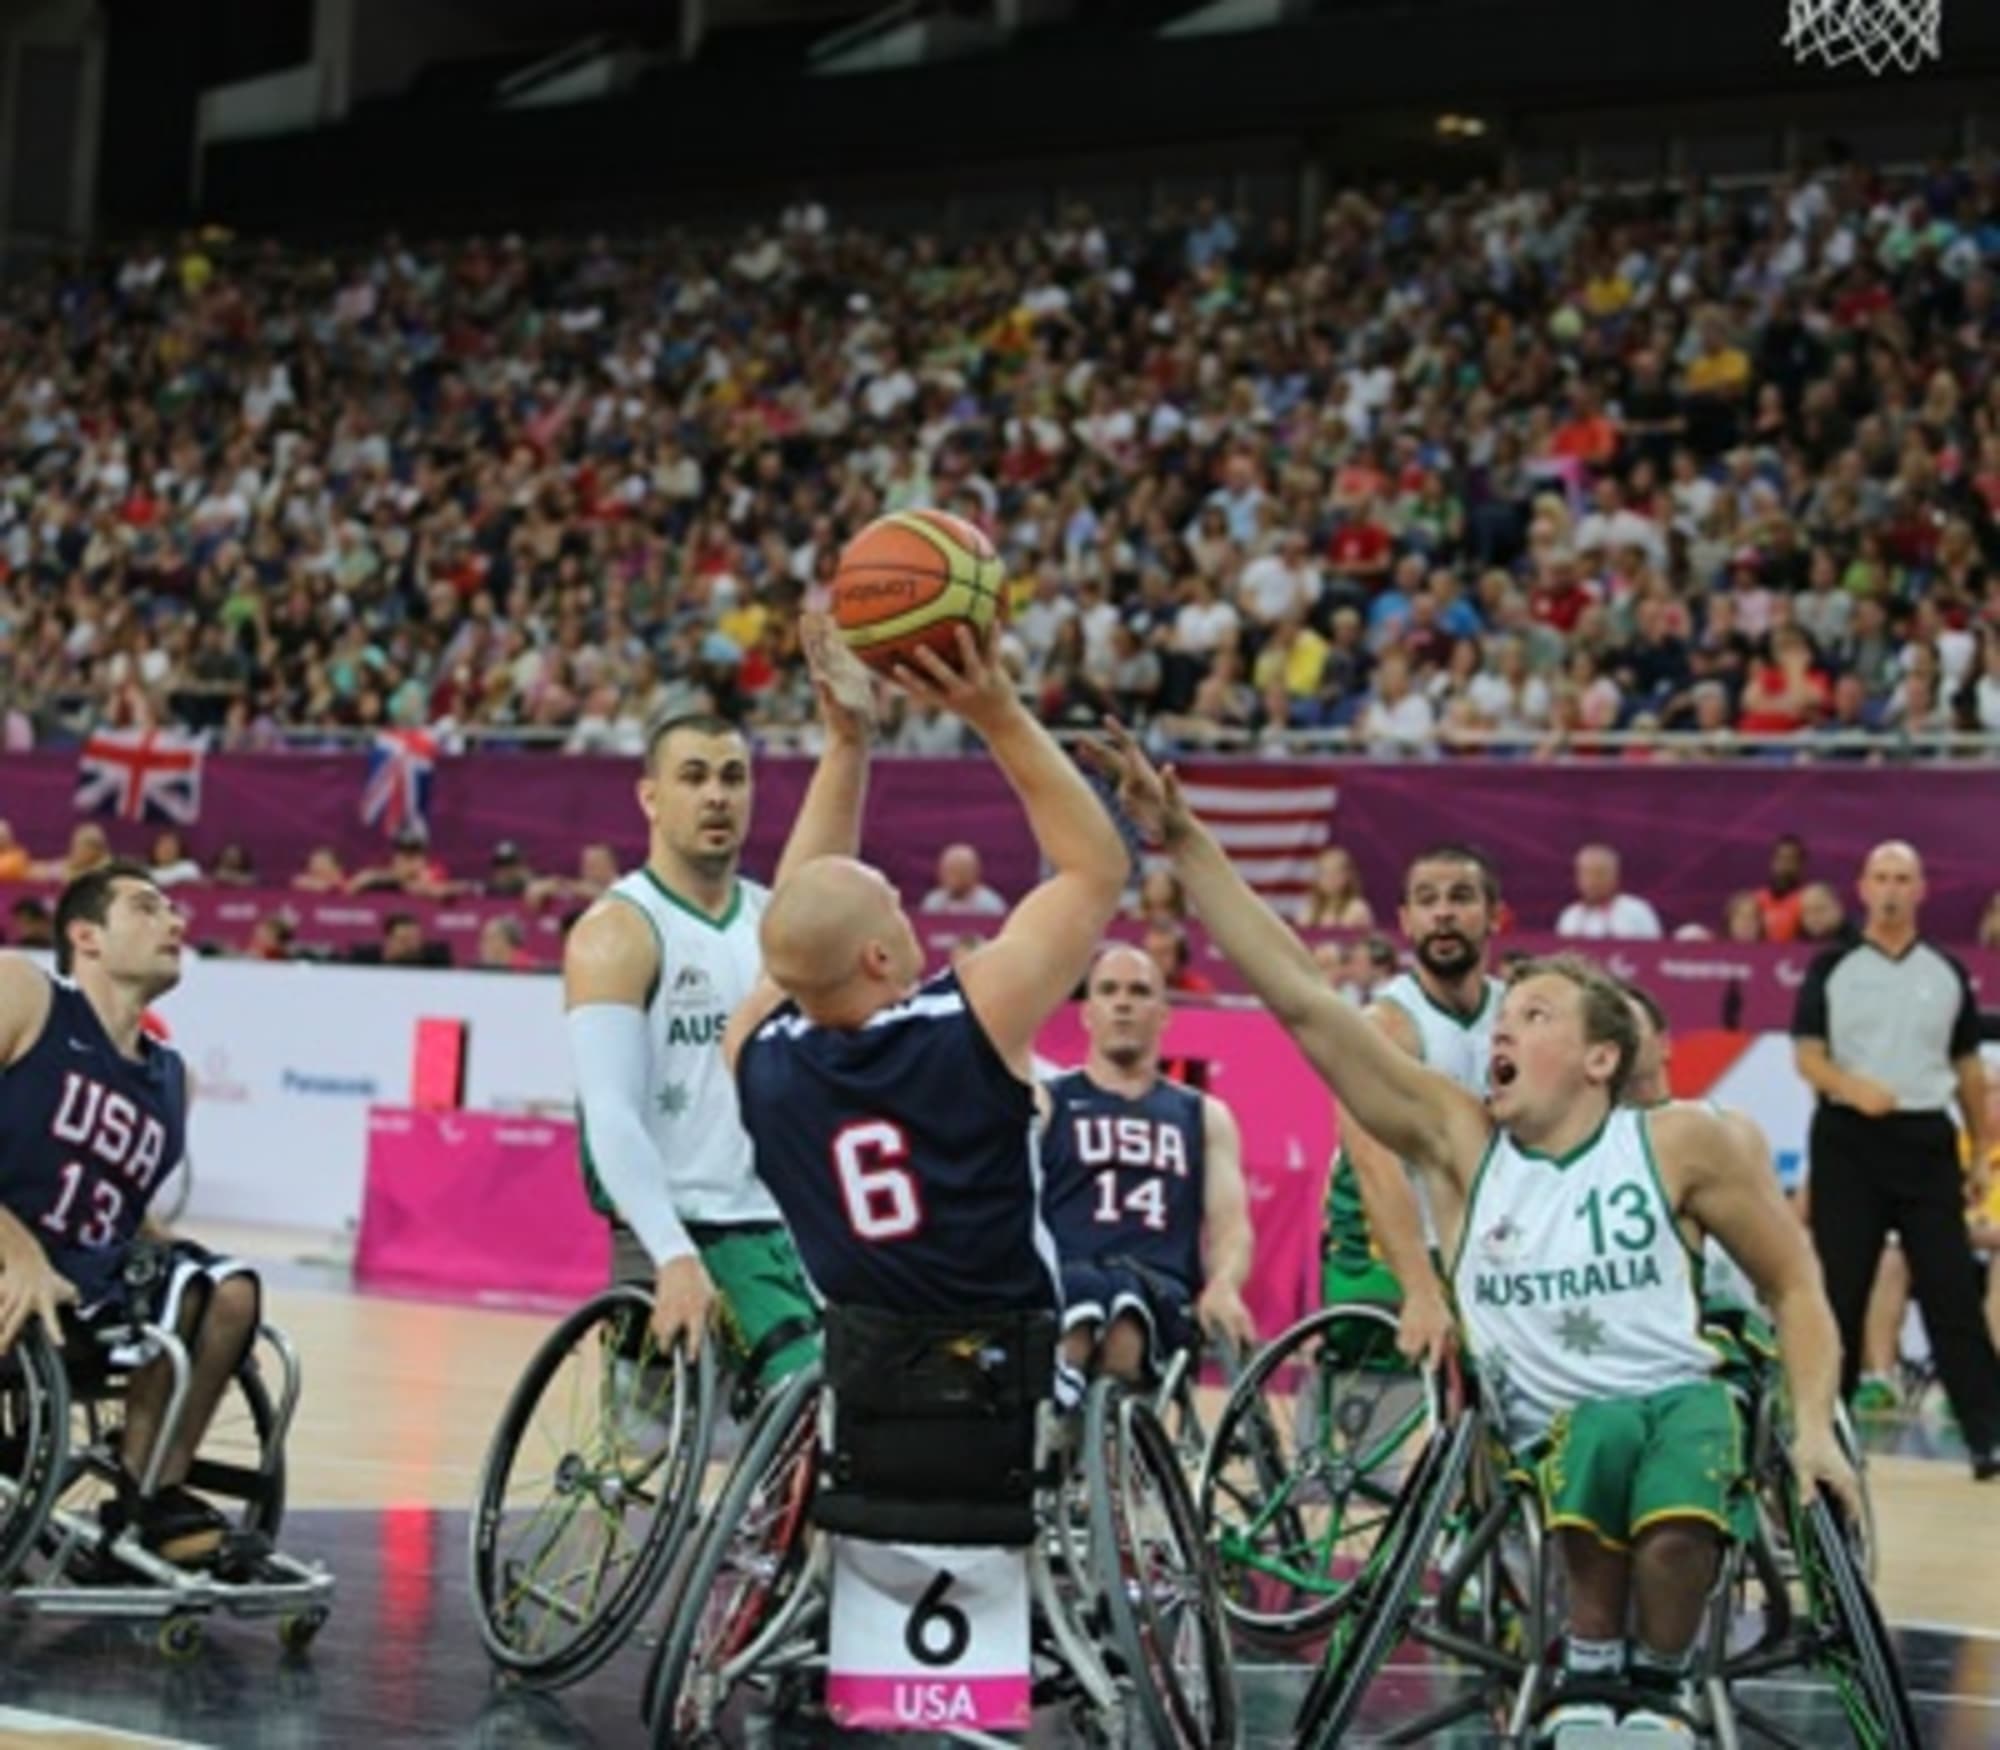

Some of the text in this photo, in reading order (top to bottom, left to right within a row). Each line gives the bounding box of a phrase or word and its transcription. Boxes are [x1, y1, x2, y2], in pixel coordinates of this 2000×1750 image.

[51, 1071, 166, 1190] USA
[1074, 1116, 1188, 1177] USA
[40, 1161, 123, 1248] 13
[832, 1117, 921, 1240] 6
[1093, 1168, 1167, 1230] 14
[1574, 1180, 1656, 1256] 13
[1474, 1255, 1662, 1307] AUSTRALIA
[904, 1568, 971, 1668] 6
[893, 1682, 978, 1722] USA
